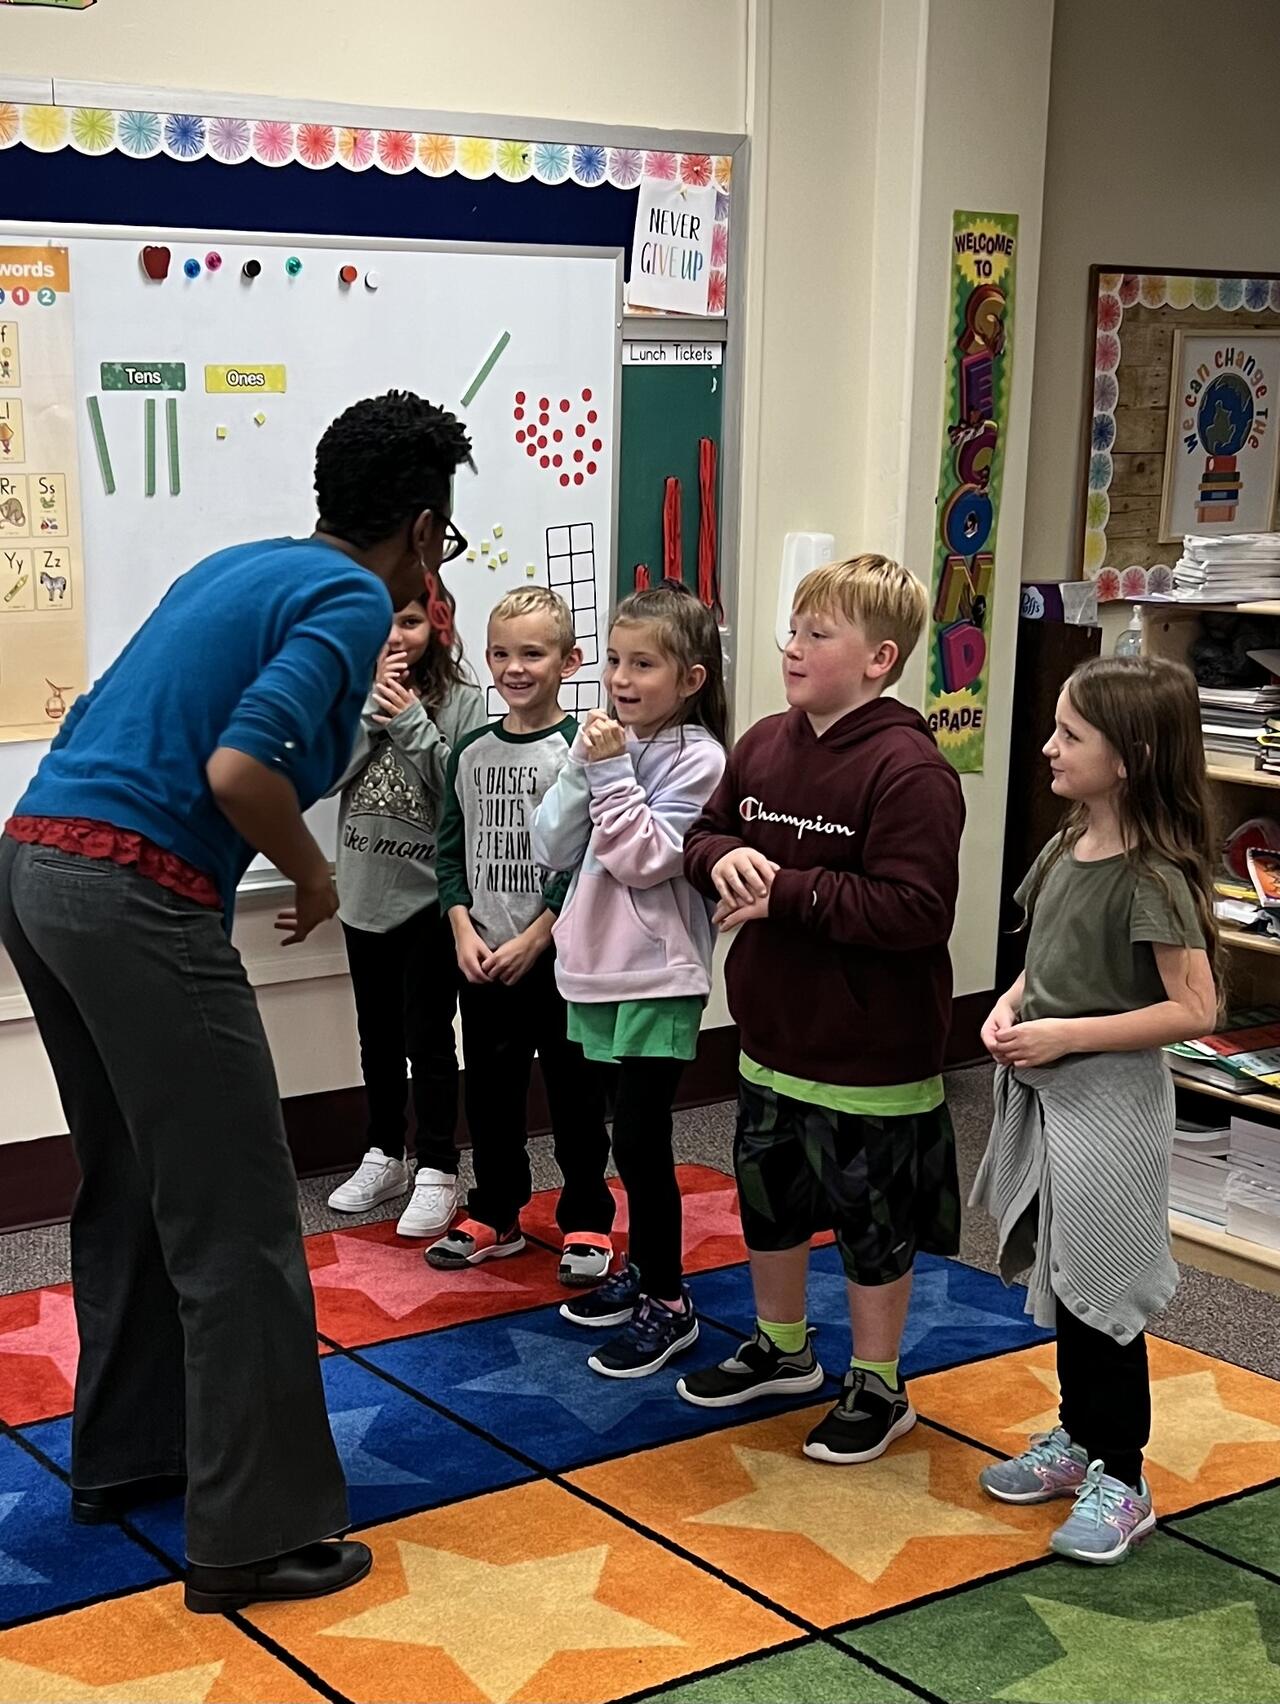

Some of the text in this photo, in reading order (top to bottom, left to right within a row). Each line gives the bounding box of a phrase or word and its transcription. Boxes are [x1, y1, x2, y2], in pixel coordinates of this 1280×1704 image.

[649, 207, 701, 241] NEVER
[955, 232, 1014, 256] WELCOME
[0, 261, 55, 278] words
[640, 241, 704, 282] GIVE UP
[974, 260, 993, 277] TO
[41, 289, 52, 303] 2
[629, 343, 713, 362] Lunch Tickets
[125, 368, 162, 385] Tens
[226, 369, 266, 387] Ones
[0, 477, 17, 495] Rr
[38, 476, 56, 495] Ss
[4, 551, 24, 575] Yy
[43, 550, 62, 568] Zz
[928, 707, 983, 733] GRADE
[474, 766, 538, 795] 4 BASES
[486, 798, 525, 828] OUTS
[739, 796, 856, 840] Champion
[343, 824, 437, 860] ike mom
